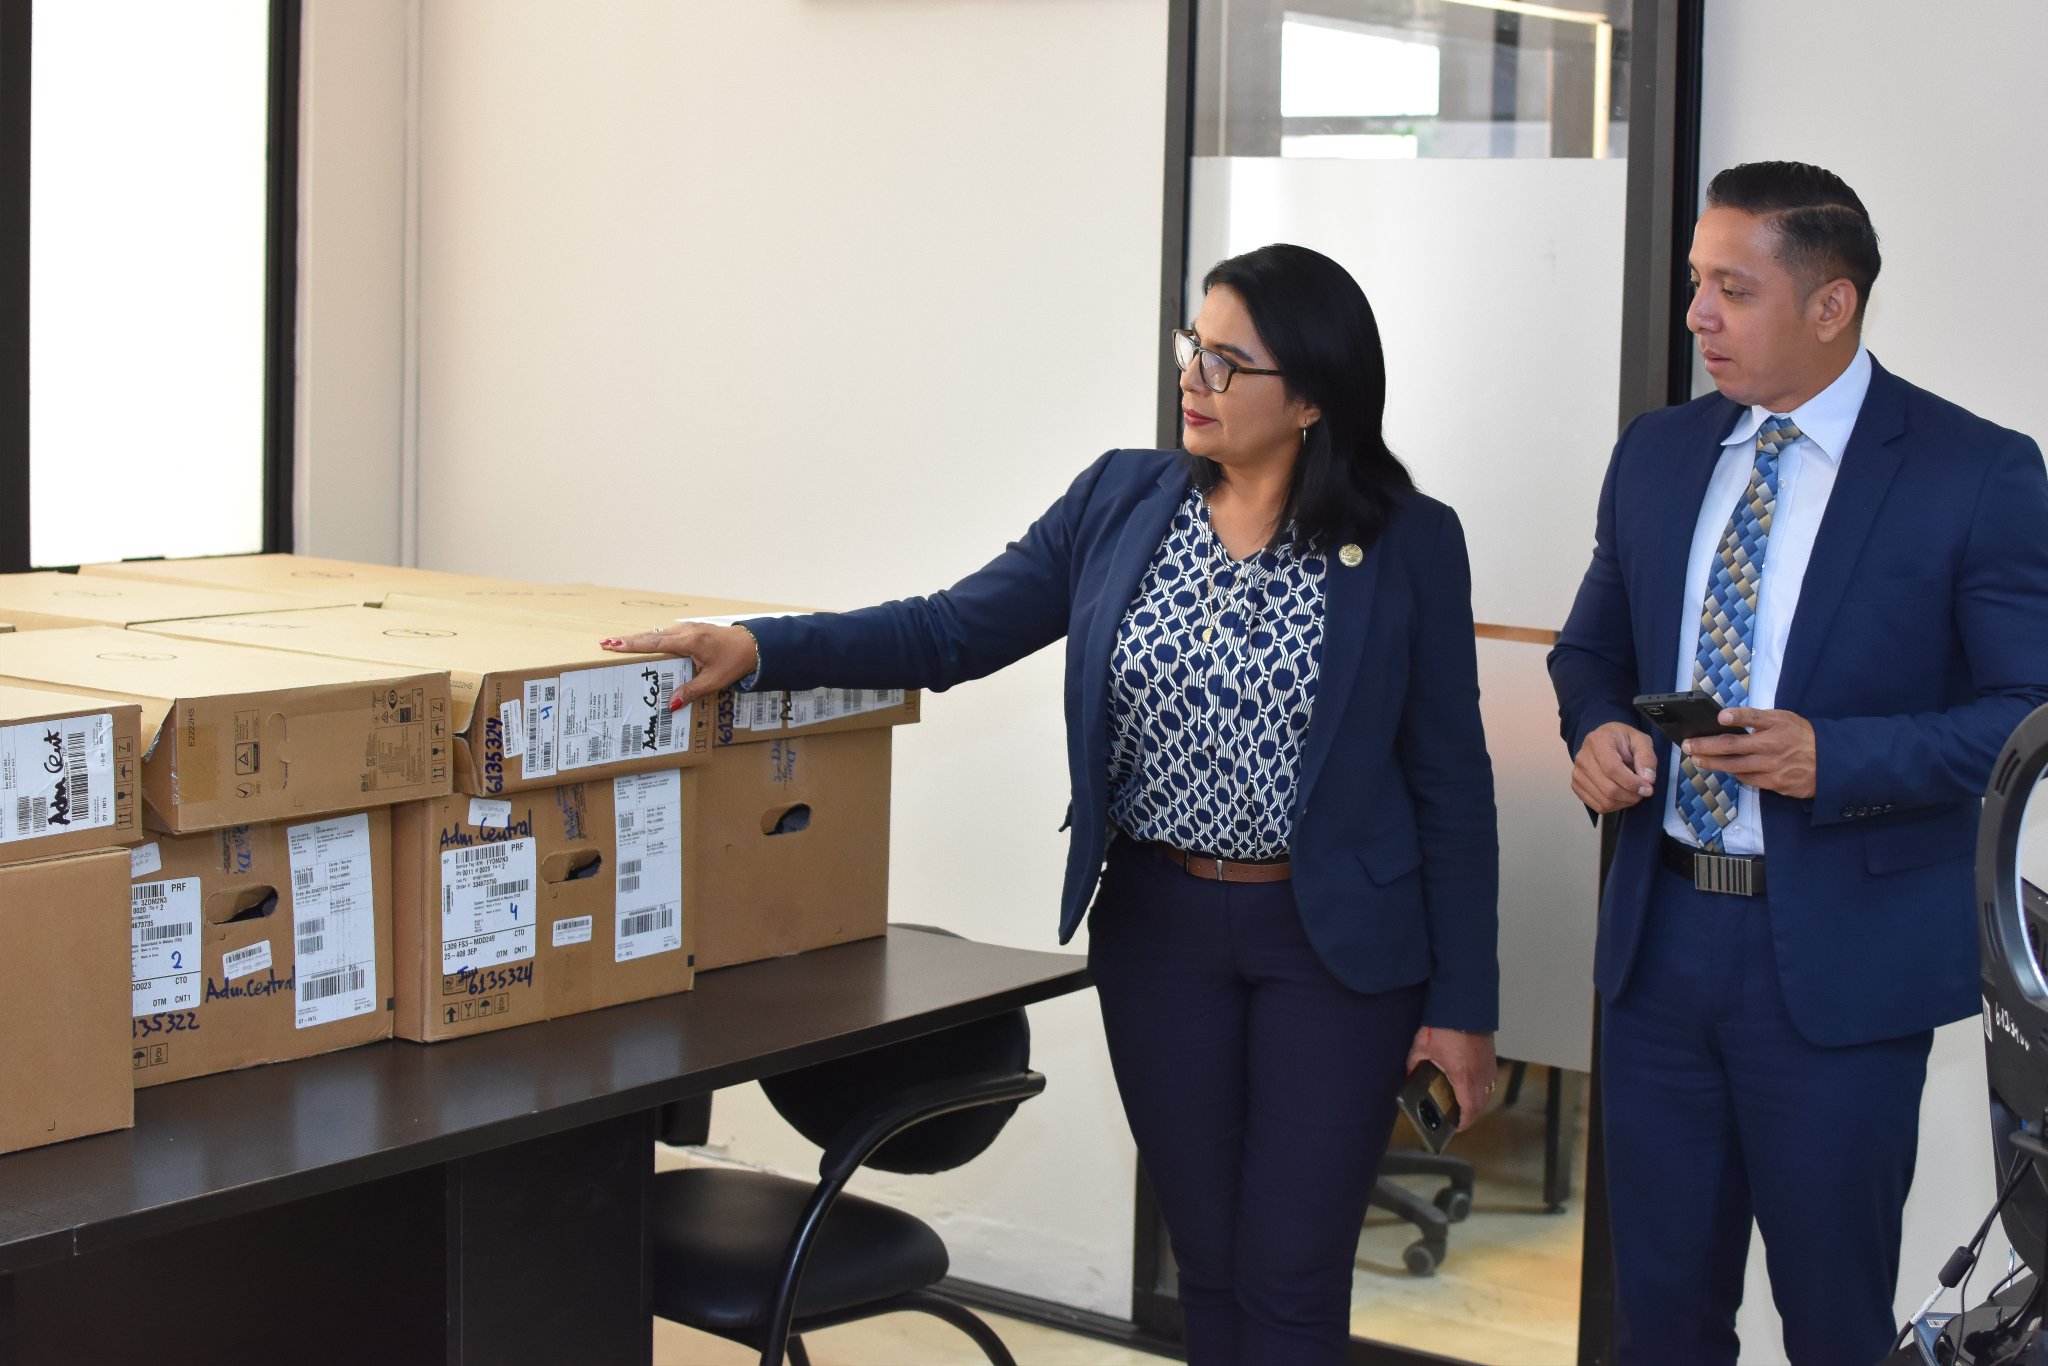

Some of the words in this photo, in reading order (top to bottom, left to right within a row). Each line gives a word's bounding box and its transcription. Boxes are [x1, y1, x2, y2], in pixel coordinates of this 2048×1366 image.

[541, 706, 552, 720] 4
[485, 716, 504, 794] 6135324
[480, 808, 532, 842] Central
[512, 842, 523, 852] PRF
[172, 883, 186, 892] PRF
[510, 903, 517, 920] 4
[171, 950, 182, 969] 2
[175, 976, 187, 984] CTO
[468, 961, 533, 995] 6135324
[175, 995, 191, 1003] CNT1
